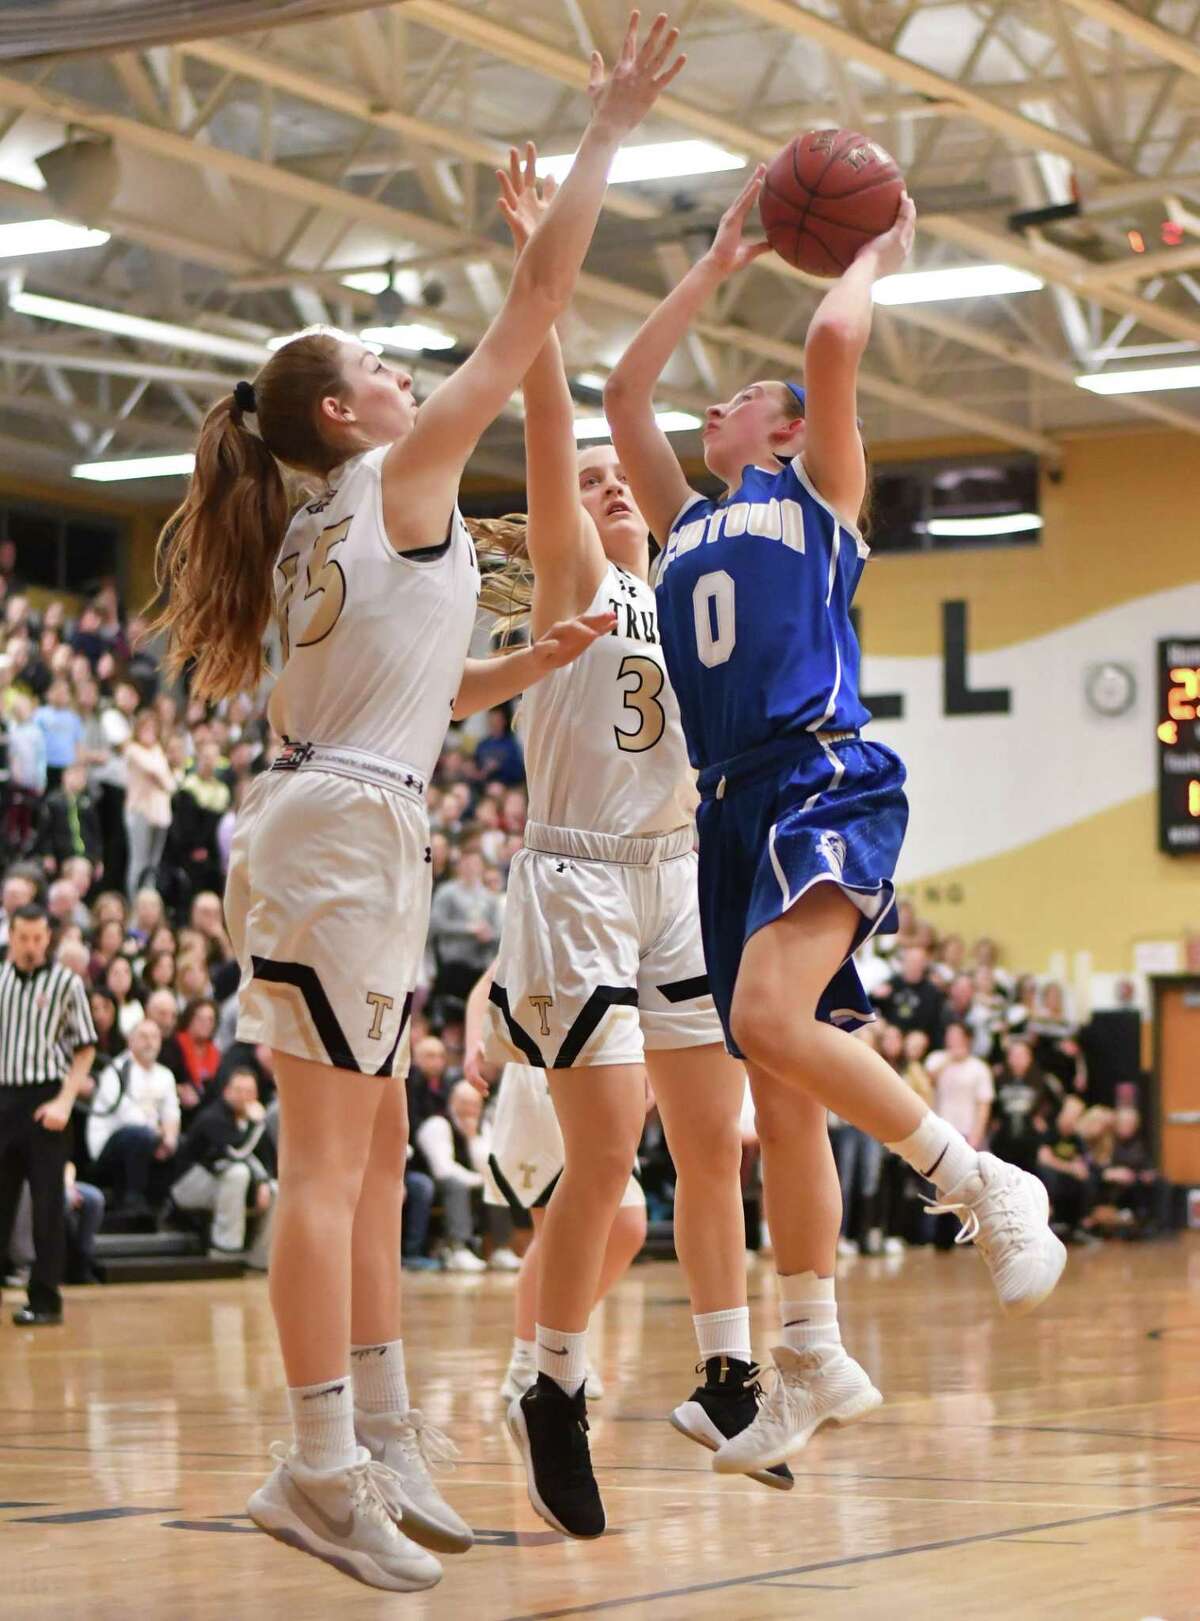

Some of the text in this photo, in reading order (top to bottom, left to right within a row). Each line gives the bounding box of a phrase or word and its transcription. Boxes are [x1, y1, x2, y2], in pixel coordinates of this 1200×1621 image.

[609, 598, 662, 645] TRU
[692, 569, 737, 669] 0
[614, 655, 666, 753] 3
[366, 991, 394, 1041] T
[528, 995, 553, 1036] T
[518, 1162, 537, 1189] T
